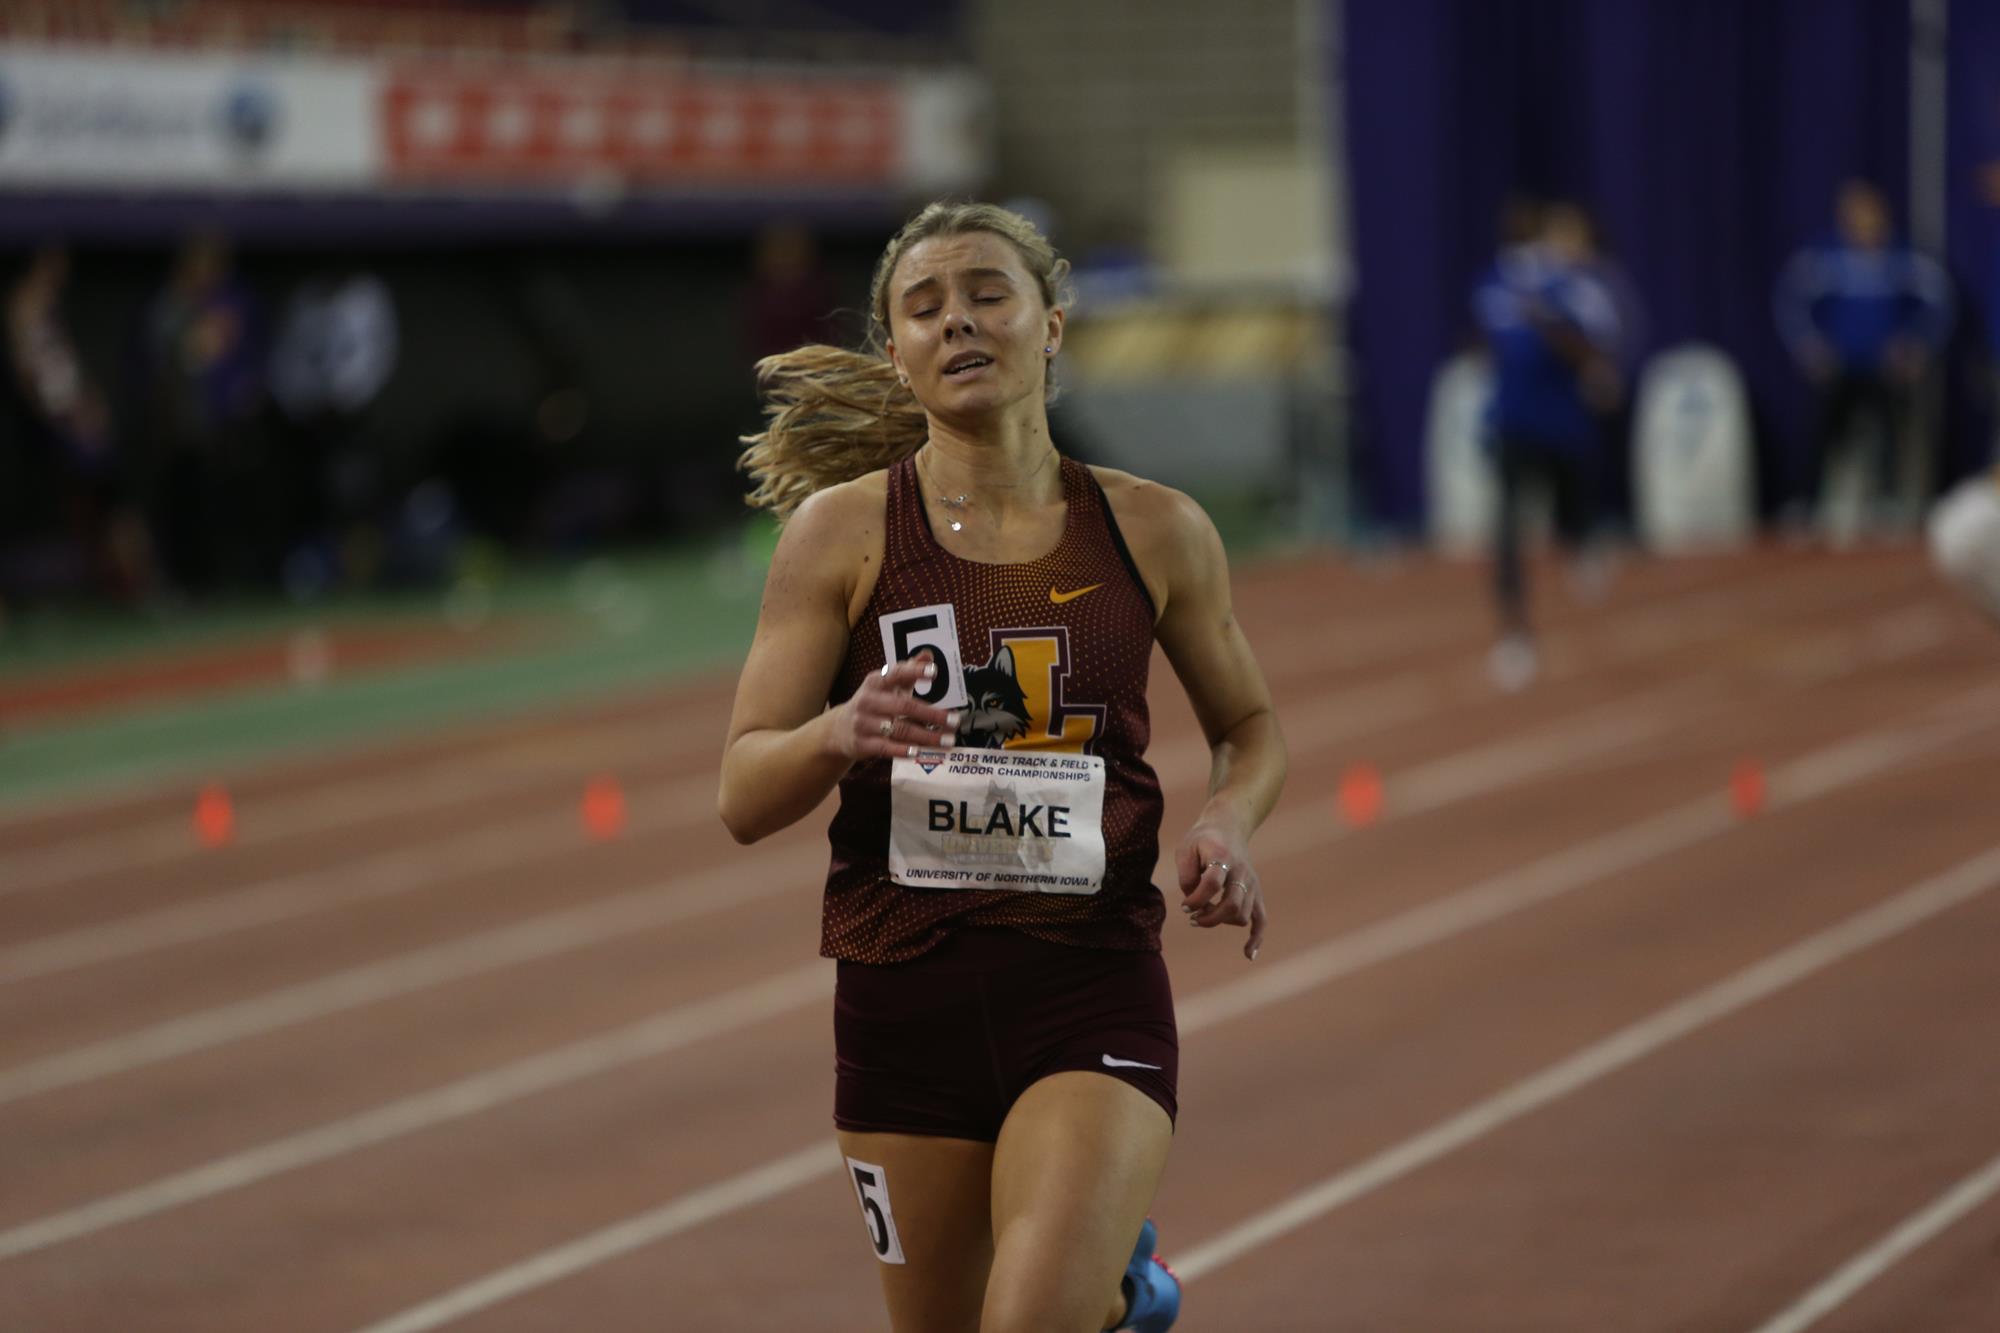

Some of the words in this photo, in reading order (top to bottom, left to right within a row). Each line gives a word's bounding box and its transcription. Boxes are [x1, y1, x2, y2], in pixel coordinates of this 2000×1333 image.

[892, 614, 950, 704] 5
[989, 626, 1106, 755] L
[948, 765, 994, 776] INDOOR
[997, 767, 1091, 782] CHAMPIONSHIPS
[950, 752, 979, 764] 2019
[981, 755, 1009, 766] MVC
[1012, 757, 1048, 768] TRACK
[1049, 758, 1058, 768] &
[1060, 760, 1089, 770] FIELD
[928, 799, 1072, 839] BLAKE
[906, 868, 973, 881] UNIVERSITY
[977, 872, 992, 882] OF
[994, 873, 1058, 885] NORTHERN
[1059, 876, 1089, 887] IOWA
[853, 1167, 889, 1255] 5
